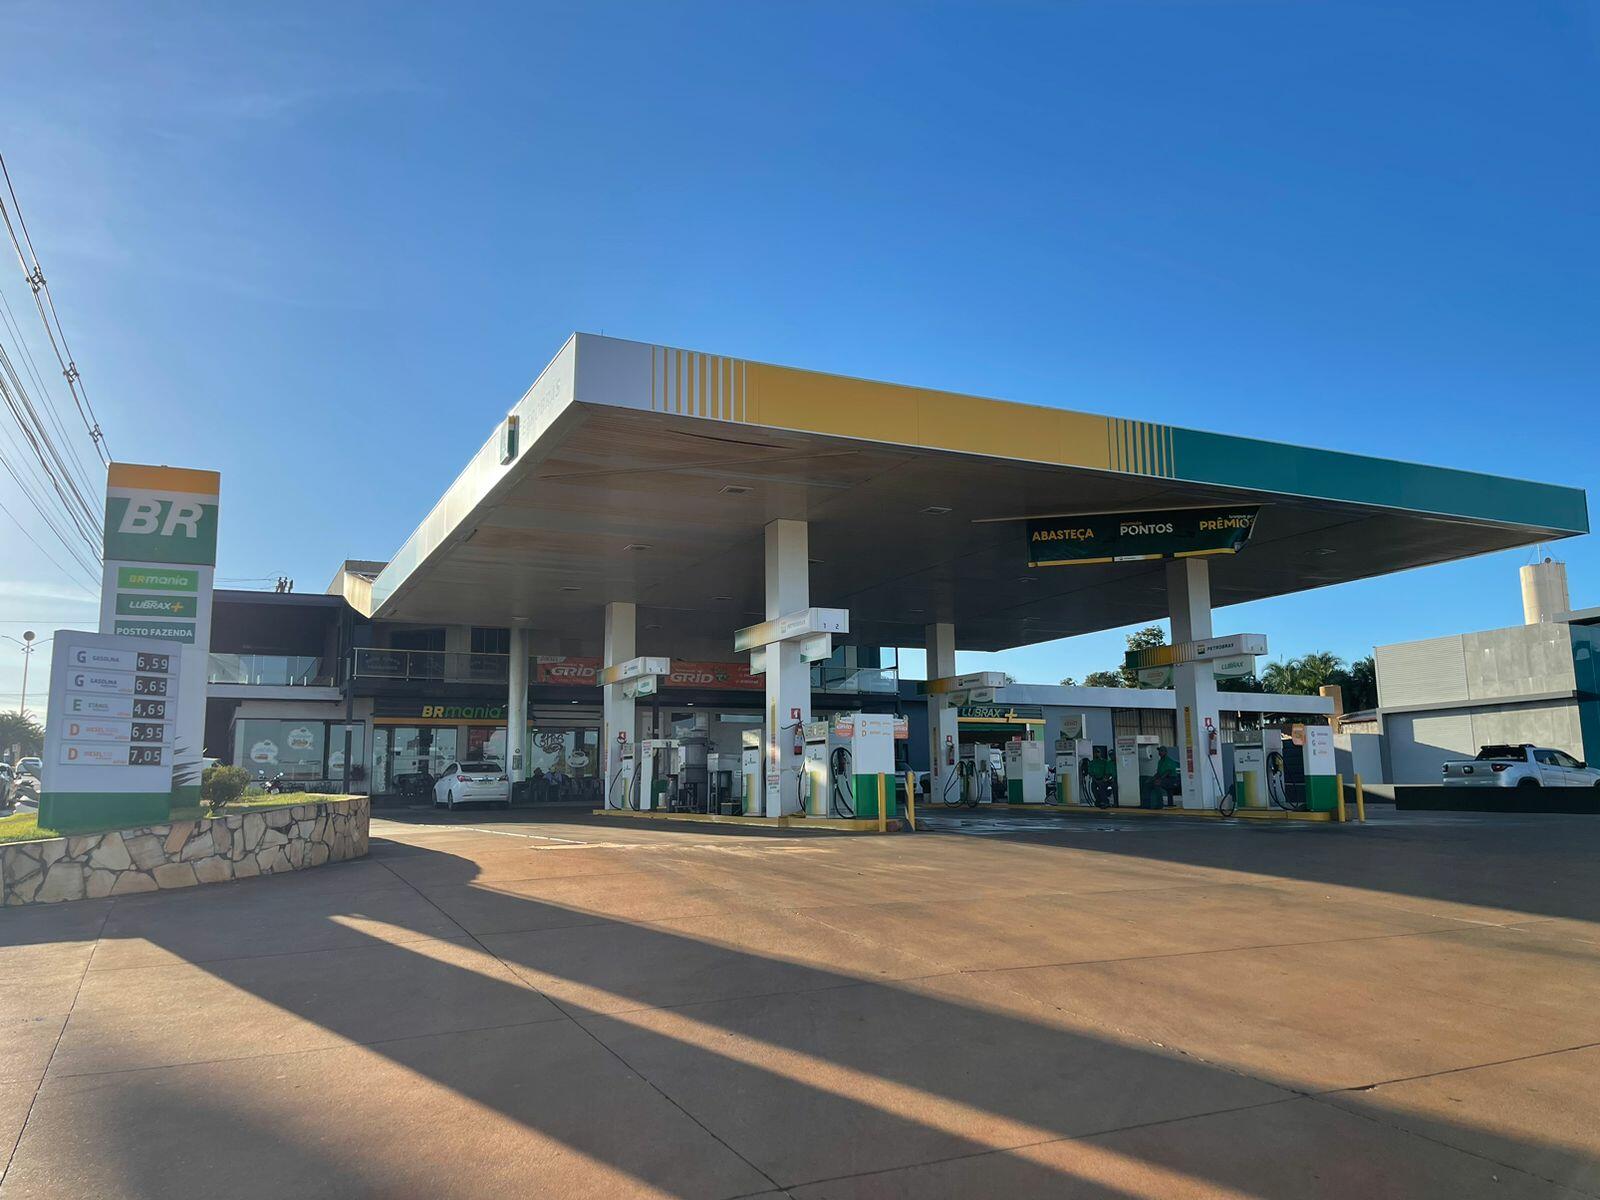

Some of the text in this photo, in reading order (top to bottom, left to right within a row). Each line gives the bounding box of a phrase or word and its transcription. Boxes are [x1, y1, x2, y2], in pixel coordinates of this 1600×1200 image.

[118, 497, 203, 538] BR
[1032, 528, 1094, 541] ABASTEÇA
[1120, 523, 1173, 536] PONTOS
[128, 574, 189, 586] BRmania
[116, 627, 193, 637] POSTO FAZENDA
[1207, 643, 1234, 651] PETROBRAS
[76, 650, 87, 663] G
[138, 656, 168, 670] 6,59
[74, 674, 84, 687] G
[136, 680, 166, 692] 6,65
[73, 699, 82, 711] E
[134, 703, 164, 716] 4,69
[421, 704, 502, 718] BRmania
[961, 707, 1001, 718] LUBRAX
[69, 723, 80, 736] D
[132, 726, 162, 739] 6,95
[68, 748, 78, 760] D
[131, 750, 160, 763] 7,05
